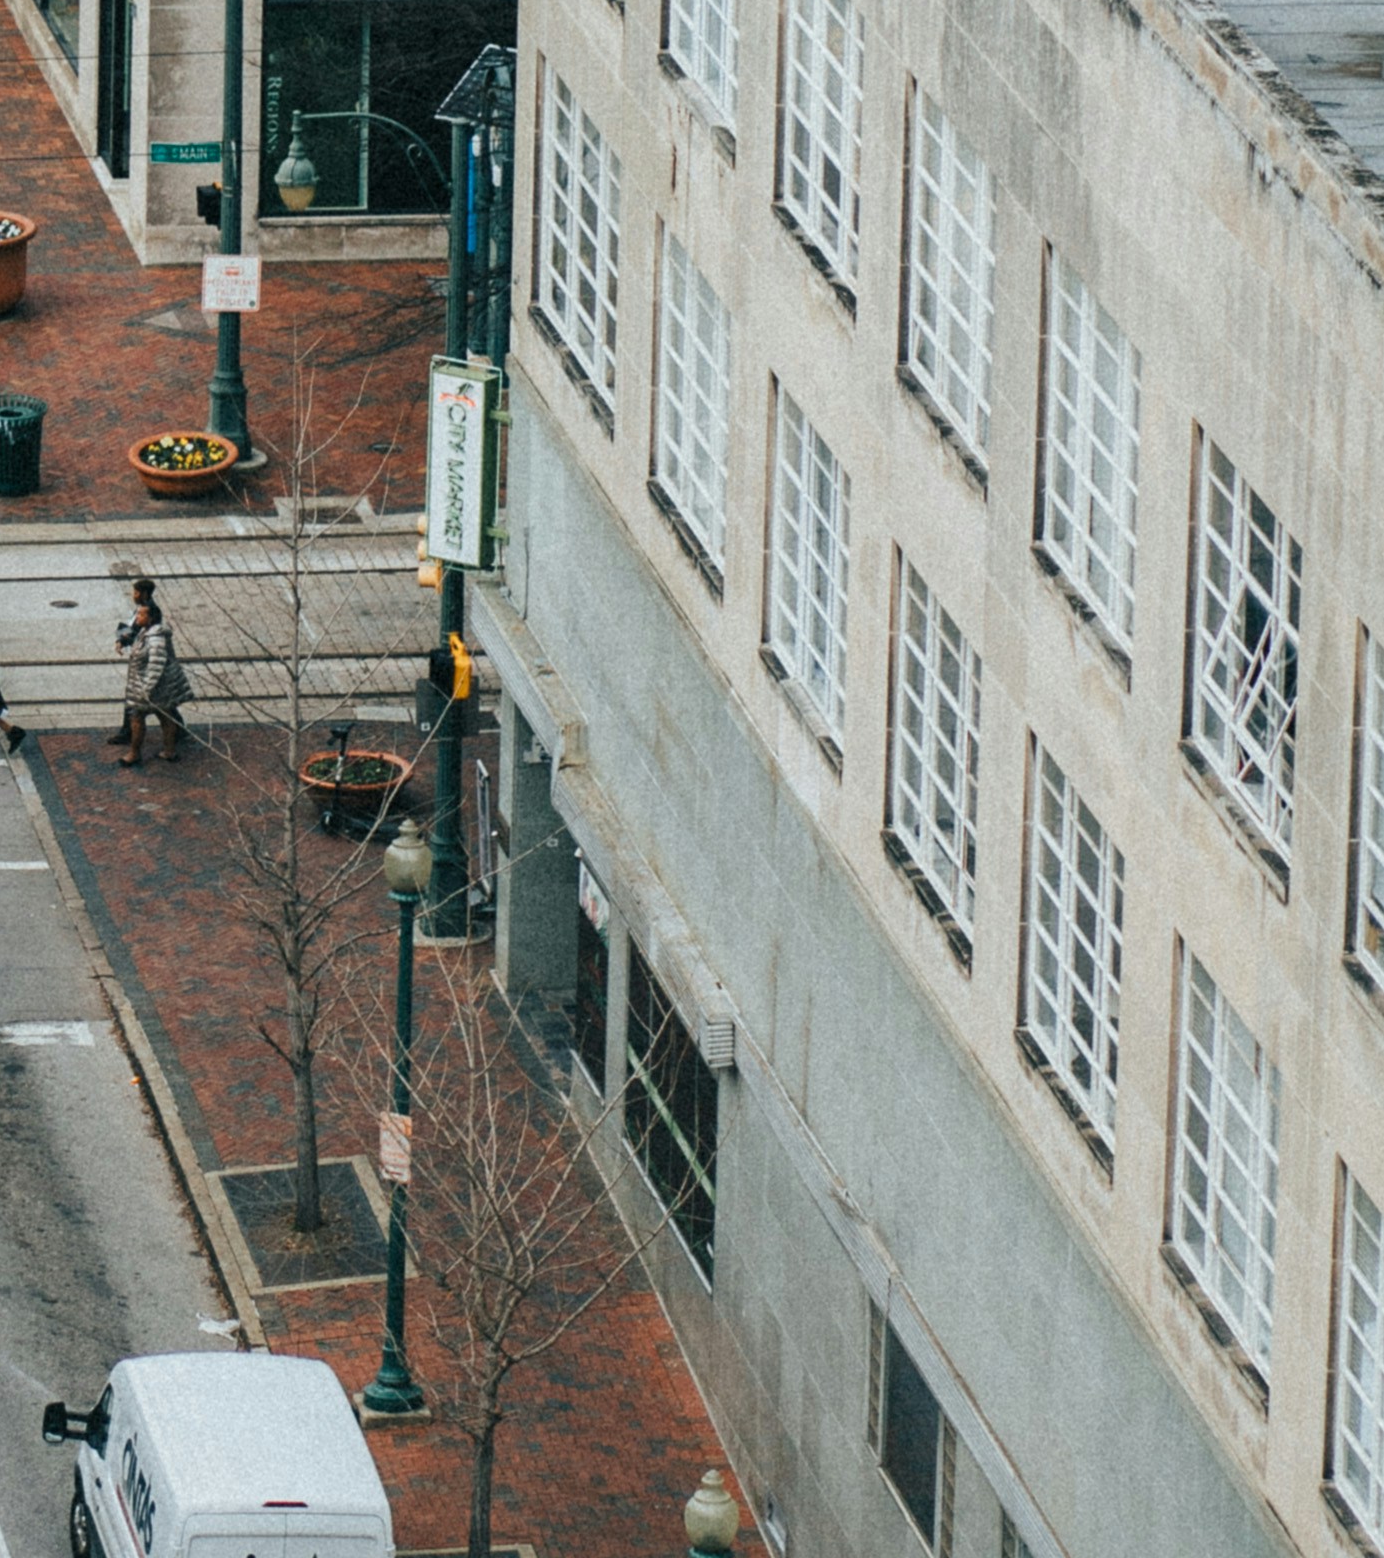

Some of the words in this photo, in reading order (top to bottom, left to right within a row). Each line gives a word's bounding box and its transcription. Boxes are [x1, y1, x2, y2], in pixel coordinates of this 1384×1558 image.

[179, 147, 208, 159] MAIN
[447, 403, 467, 454] CITY
[444, 459, 465, 551] MARKET
